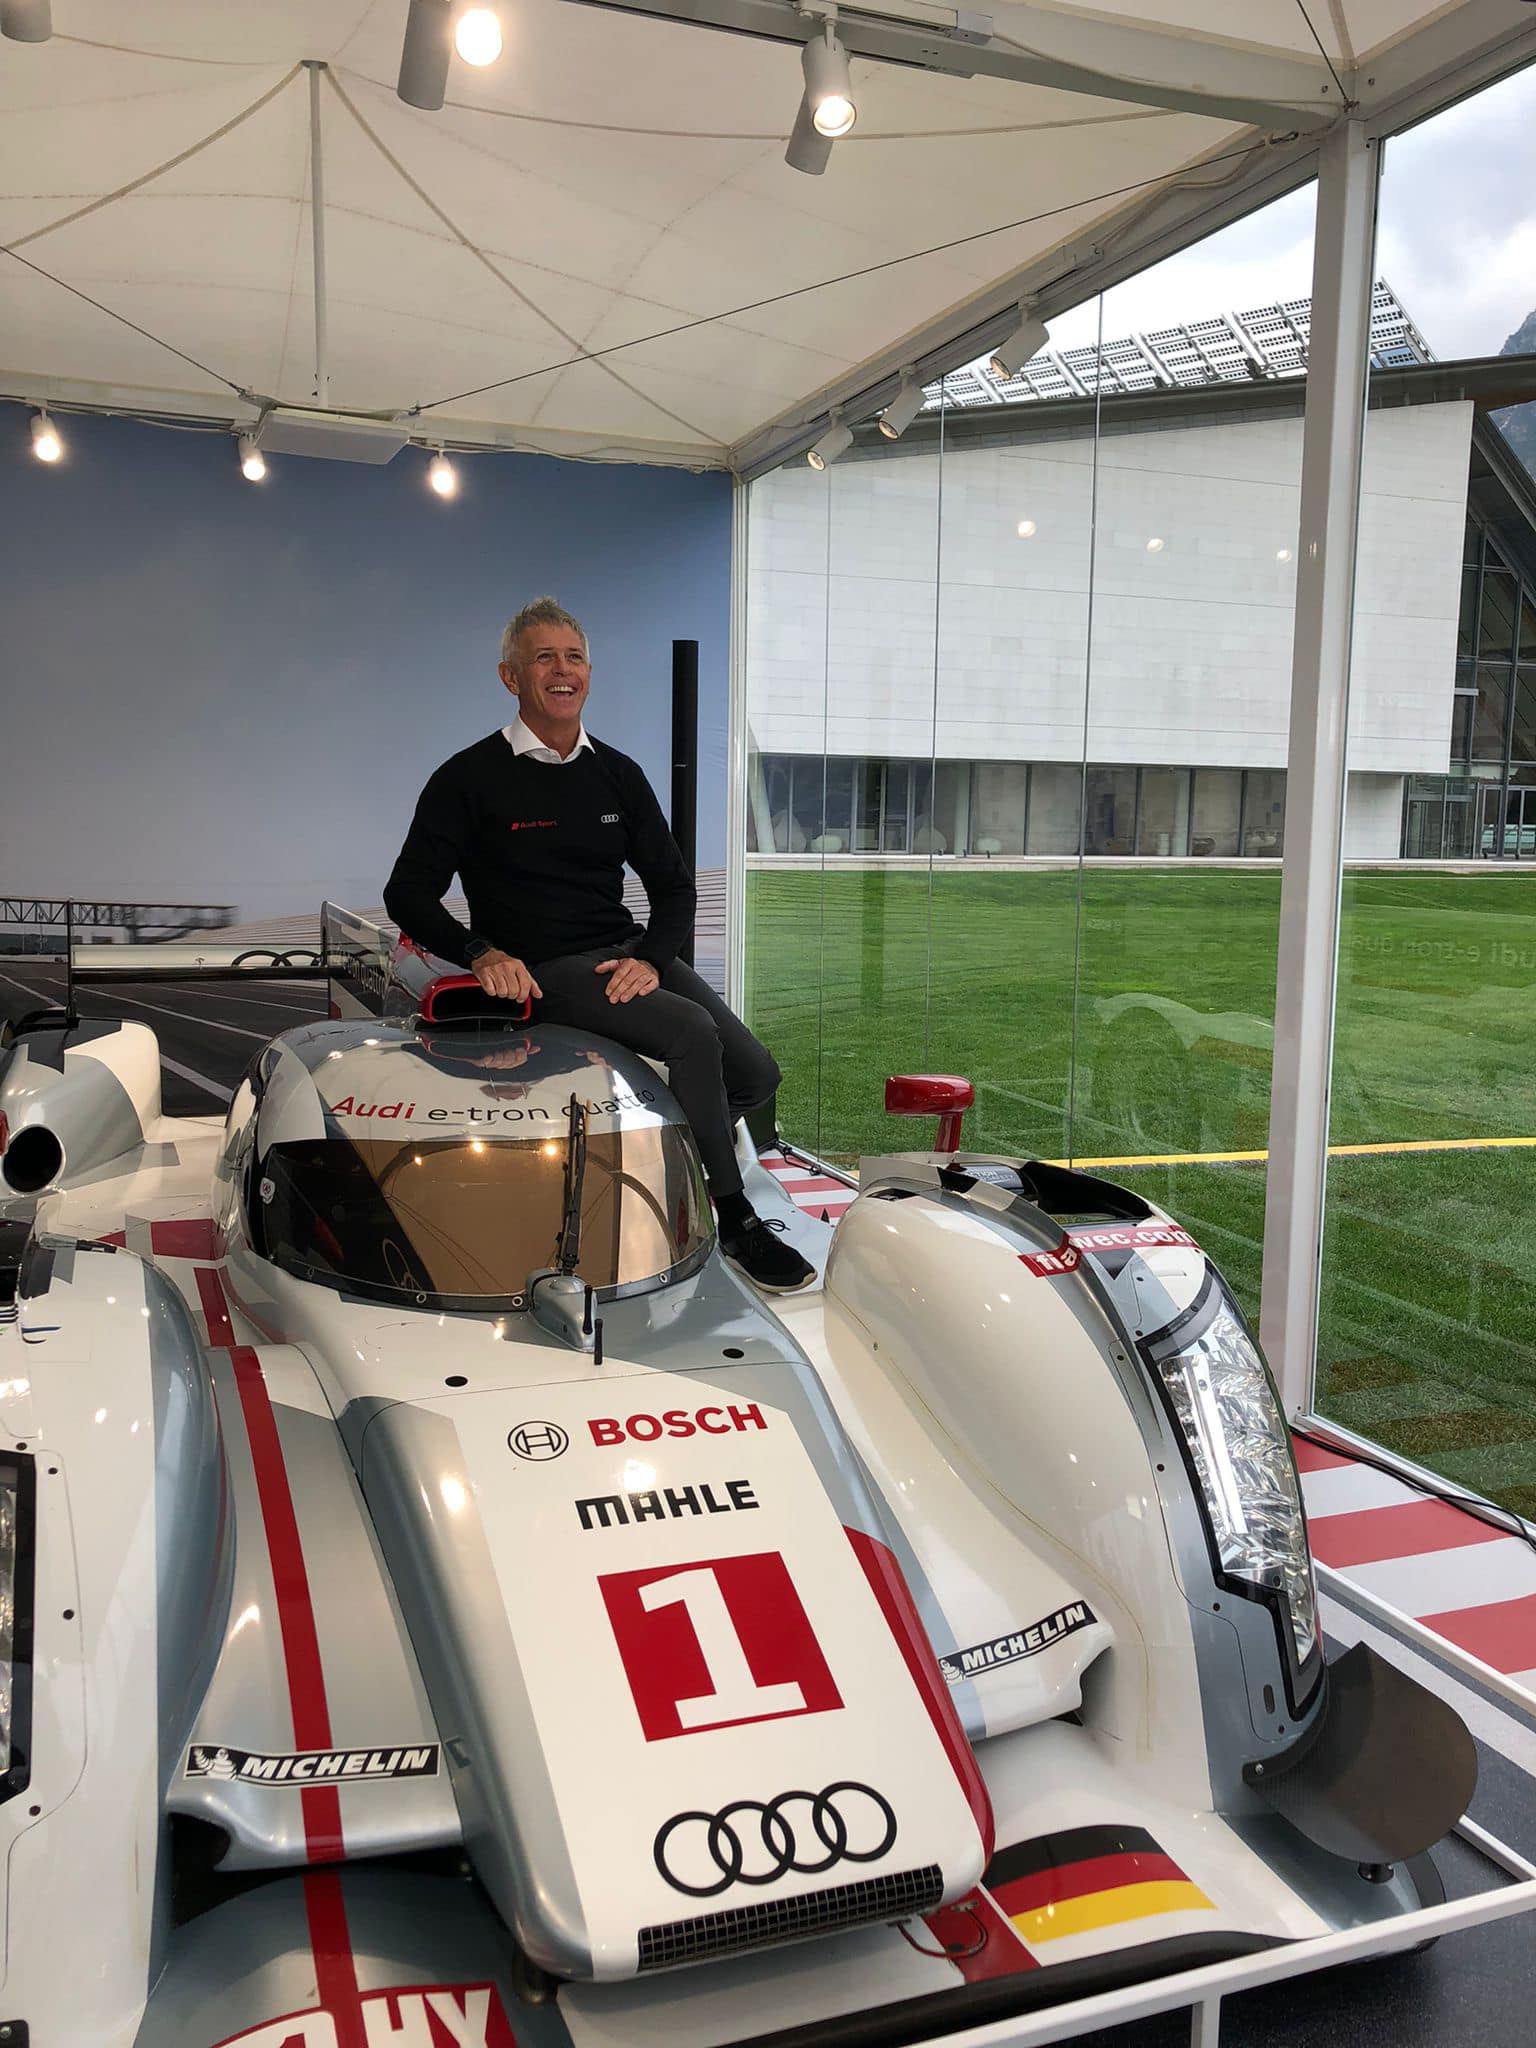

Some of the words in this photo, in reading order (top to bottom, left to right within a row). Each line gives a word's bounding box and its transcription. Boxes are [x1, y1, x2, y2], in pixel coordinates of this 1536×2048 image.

[329, 1096, 415, 1120] Audi
[427, 1103, 550, 1121] e-tron
[587, 1403, 769, 1447] BOSCH
[575, 1480, 760, 1530] MAHLE
[638, 1567, 808, 1729] 1
[961, 1604, 1087, 1671] MICHELIN
[241, 1750, 432, 1780] MICHELIN
[361, 1987, 491, 2048] HY
